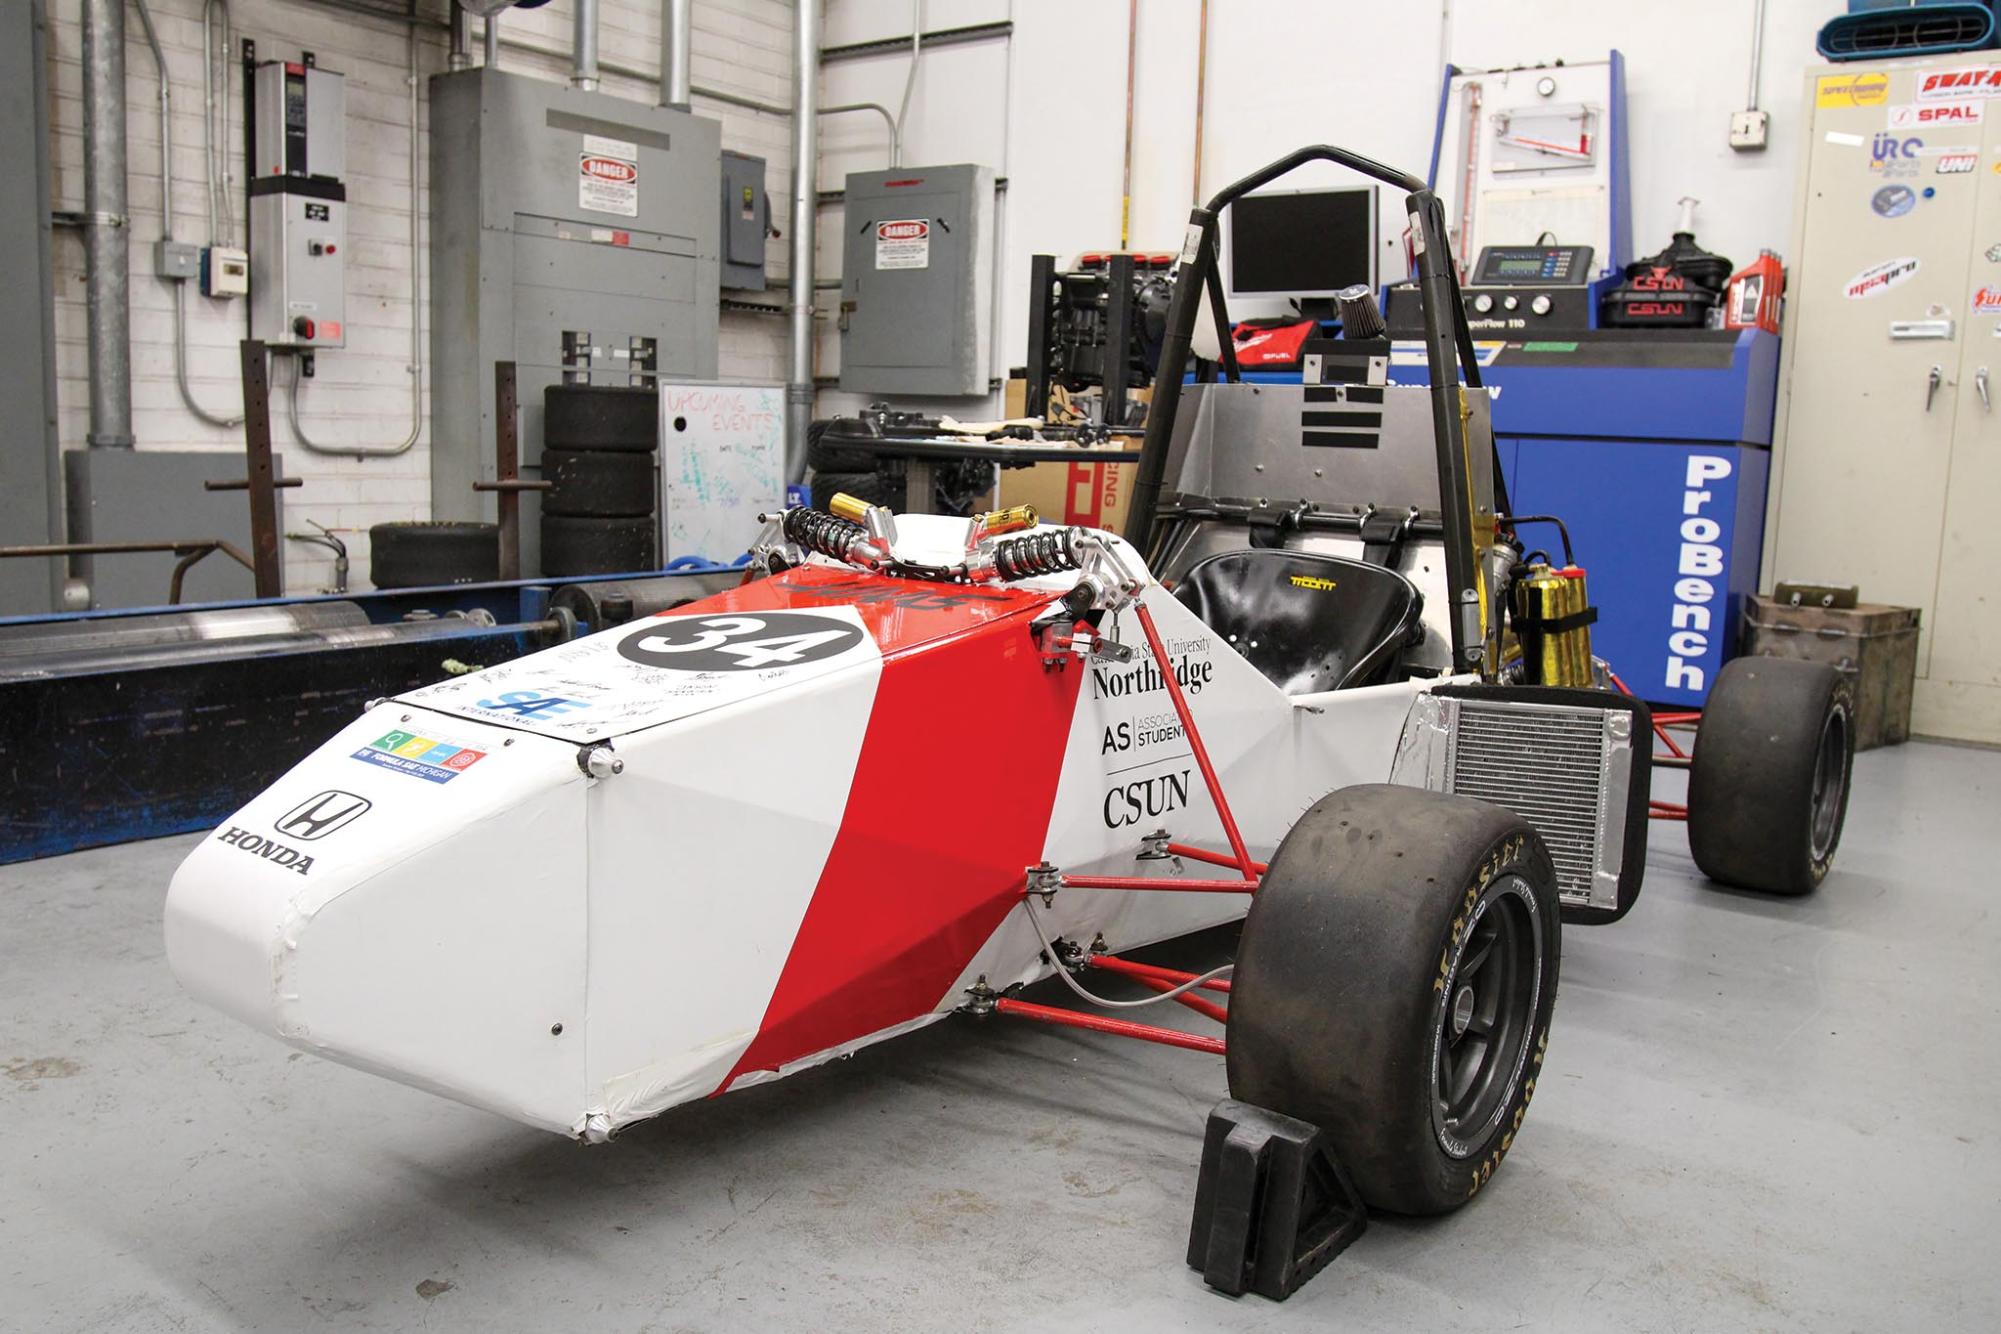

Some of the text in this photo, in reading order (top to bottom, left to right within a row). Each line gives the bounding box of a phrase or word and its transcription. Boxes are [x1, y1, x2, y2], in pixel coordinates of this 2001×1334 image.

[1918, 106, 1979, 121] SPAL
[588, 160, 629, 179] DANGER
[1936, 154, 1977, 174] UNI
[884, 224, 921, 237] DANGER
[1627, 302, 1684, 316] CSUN
[712, 413, 773, 432] EVENTS
[1664, 454, 1733, 692] ProBench
[637, 617, 853, 668] 34
[1166, 634, 1212, 656] University
[476, 690, 593, 721] SAE
[1101, 721, 1132, 756] AS
[1138, 723, 1186, 747] STUDENT
[1103, 769, 1191, 829] CSUN
[217, 825, 316, 876] HONDA
